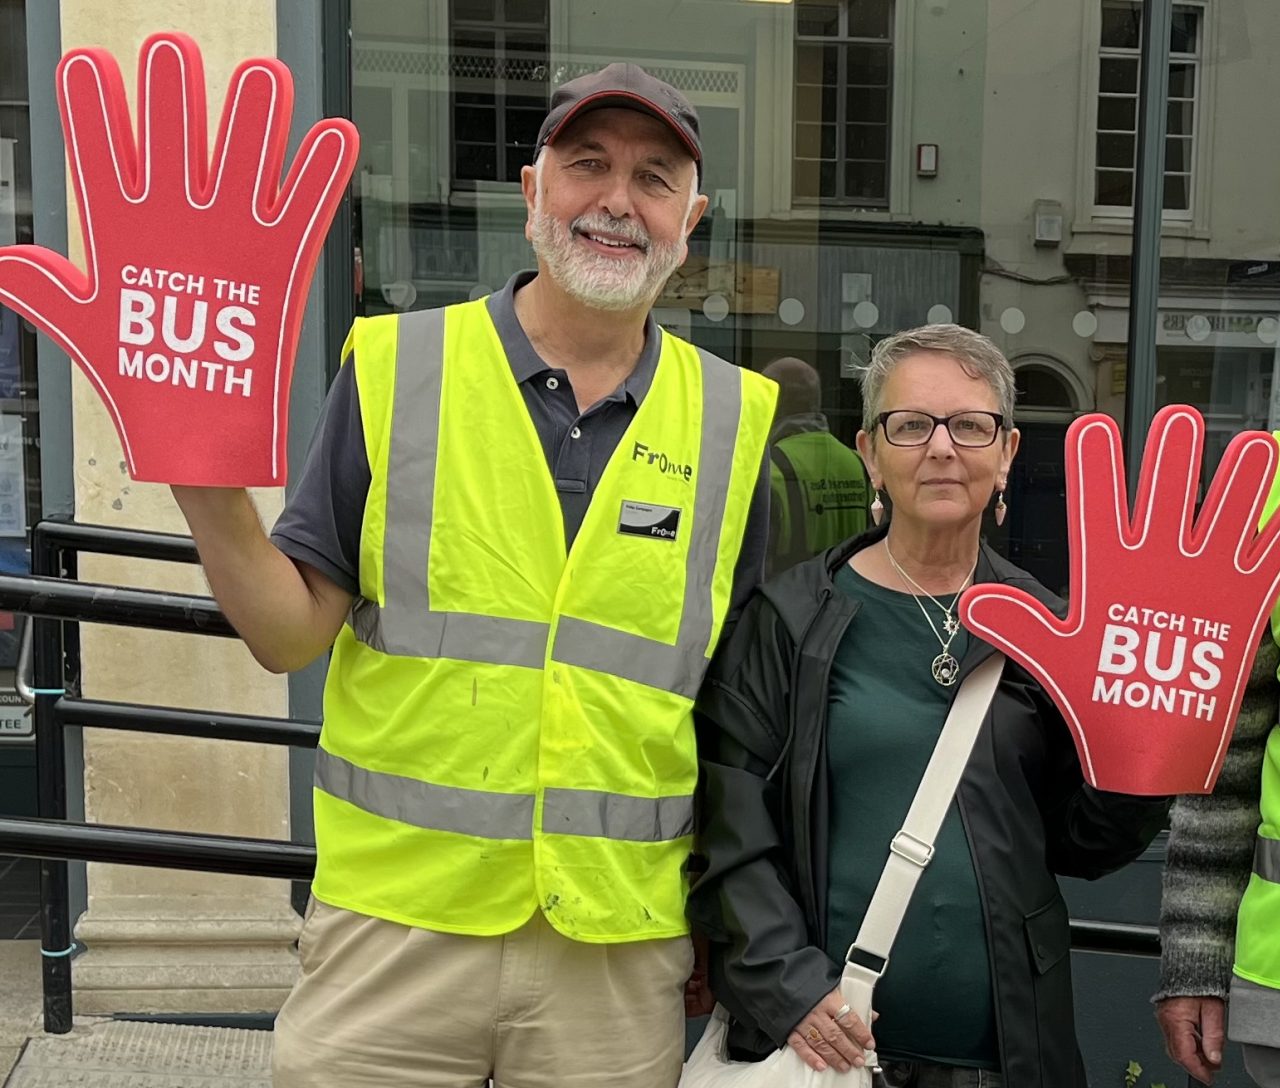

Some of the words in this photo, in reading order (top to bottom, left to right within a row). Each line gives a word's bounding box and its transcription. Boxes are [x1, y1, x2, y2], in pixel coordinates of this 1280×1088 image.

[121, 265, 205, 296] CATCH
[213, 278, 261, 306] THE
[118, 287, 257, 362] BUS
[118, 347, 253, 397] MONTH
[632, 441, 693, 482] Frome
[1107, 603, 1186, 632] CATCH
[1192, 617, 1231, 642] THE
[1097, 623, 1225, 690] BUS
[1091, 675, 1217, 721] MONTH
